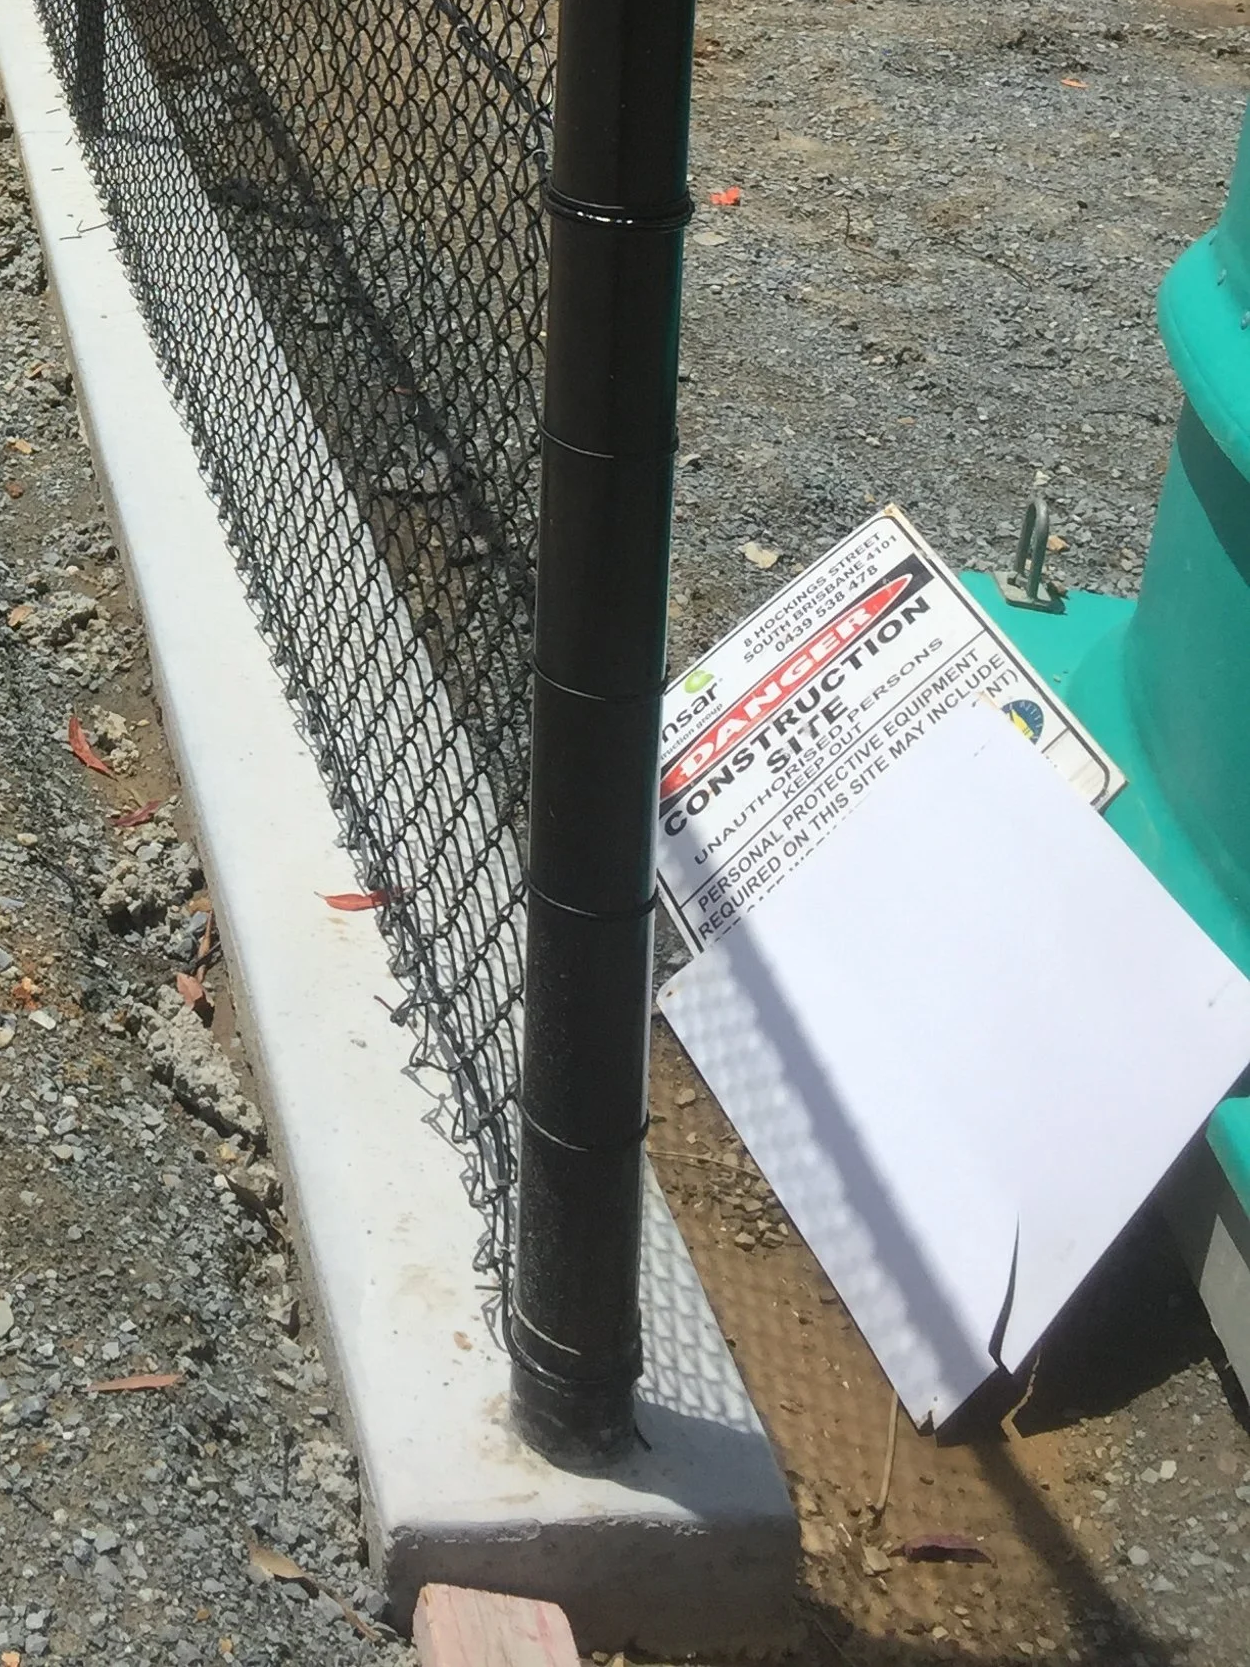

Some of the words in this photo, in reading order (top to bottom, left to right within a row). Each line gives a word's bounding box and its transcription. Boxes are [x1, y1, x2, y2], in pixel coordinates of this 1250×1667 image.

[743, 620, 791, 663] SOUTH
[792, 560, 865, 621] BRISBANE
[866, 535, 897, 561] 4101
[754, 576, 827, 638] HOCKINGS
[828, 532, 882, 576] STREET
[775, 617, 813, 652] 0439
[815, 591, 845, 618] 538
[848, 565, 878, 591] 478
[661, 682, 717, 743] nsar
[664, 596, 931, 837] CONSTRUCTION
[680, 607, 872, 777] DANGER
[696, 703, 723, 730] group
[767, 695, 848, 774] SITE
[694, 724, 842, 865] UNAUTHORISED
[847, 637, 943, 722] PERSONS
[697, 830, 784, 913] PERSONAL
[782, 734, 884, 830] PROTECTIVE
[883, 648, 980, 737] EQUIPMENT
[697, 855, 782, 940] REQUIRED
[783, 829, 810, 857] ON
[808, 792, 849, 831] THIS
[850, 754, 889, 795] SITE
[888, 720, 926, 759] MAY
[927, 653, 1005, 725] INCLUDE
[782, 756, 825, 800] KEEP
[829, 721, 862, 756] OUT
